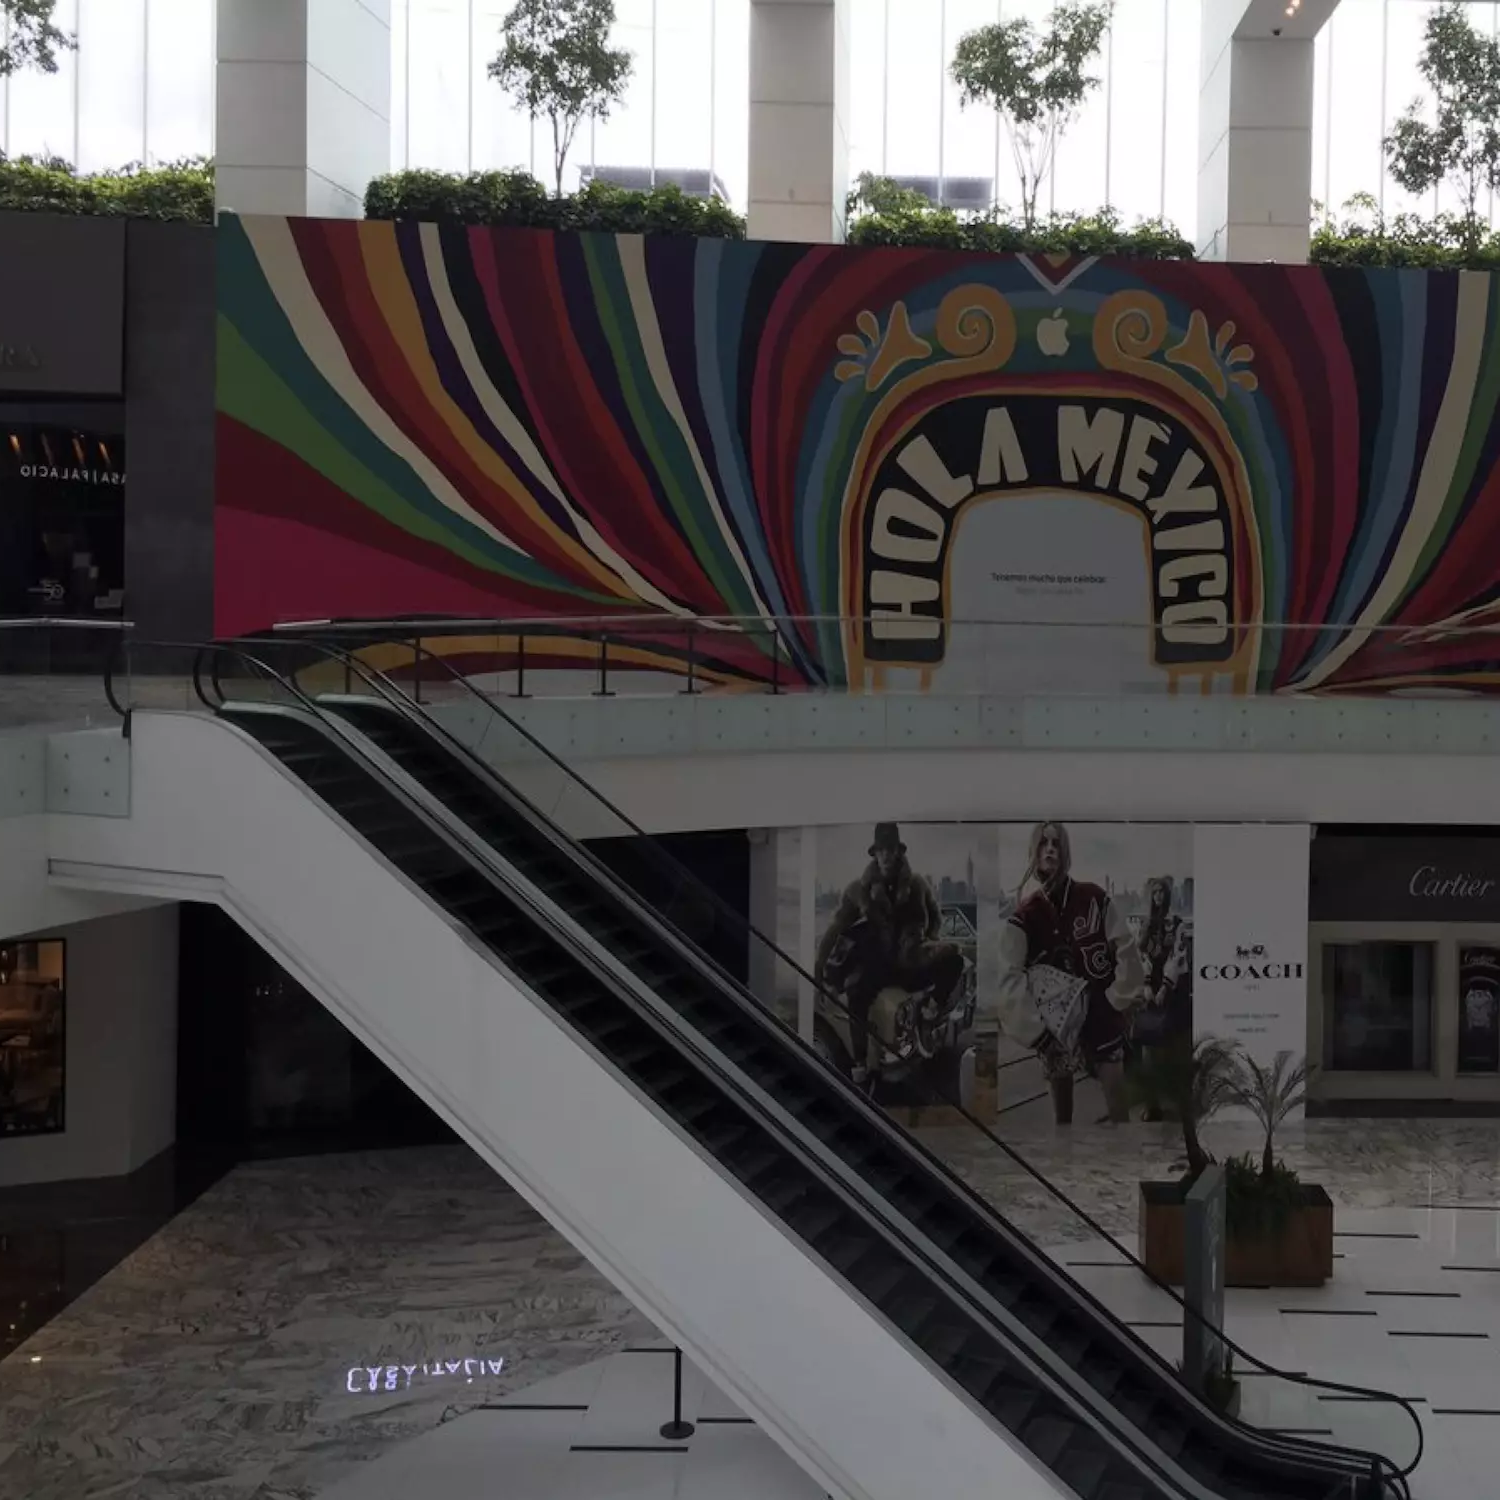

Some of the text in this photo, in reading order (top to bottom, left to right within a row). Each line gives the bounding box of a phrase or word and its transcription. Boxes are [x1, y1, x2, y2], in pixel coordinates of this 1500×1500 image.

[871, 407, 1029, 640] HOLA
[1409, 864, 1496, 898] Cartier
[1199, 963, 1304, 981] COACH
